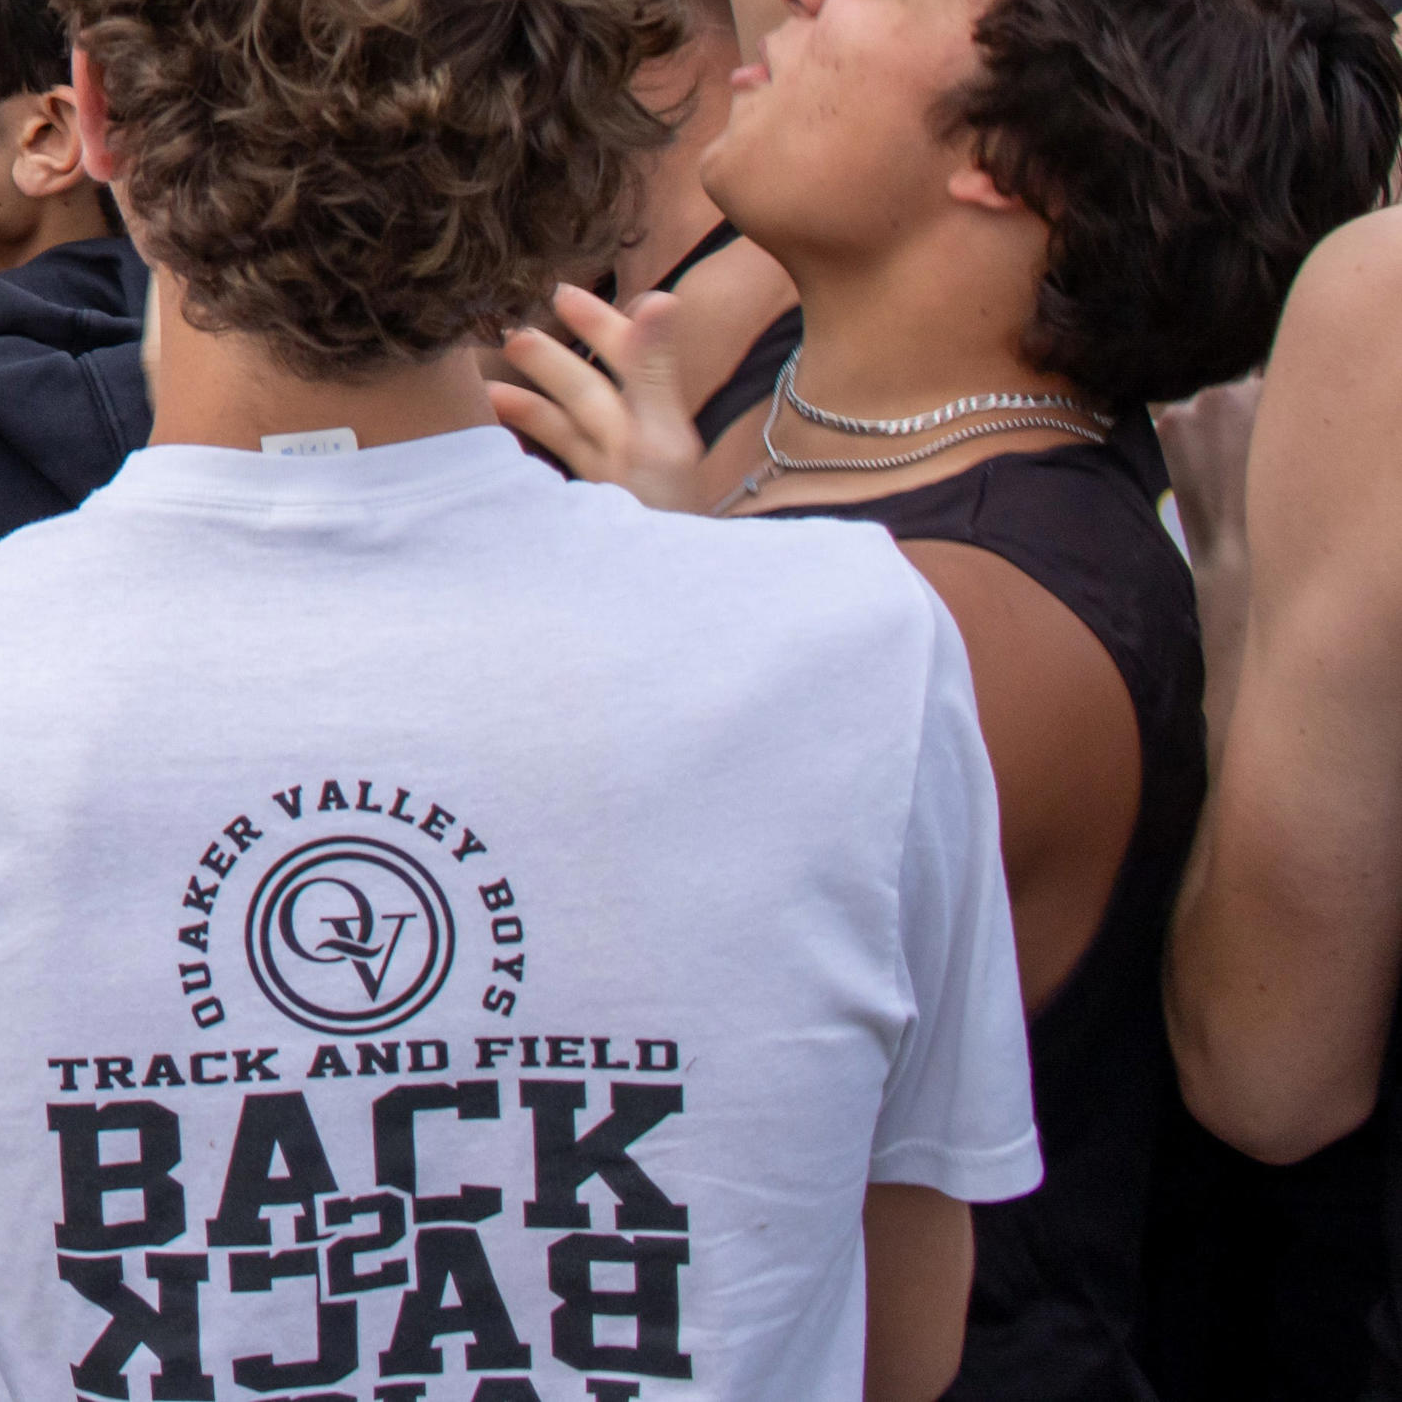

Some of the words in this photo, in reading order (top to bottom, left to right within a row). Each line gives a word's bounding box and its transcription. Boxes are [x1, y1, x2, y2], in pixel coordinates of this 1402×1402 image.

[178, 814, 263, 1029] QUAKER
[272, 779, 487, 863] VALLEY
[478, 877, 525, 1017] BOYS
[278, 877, 418, 1002] QV
[47, 1048, 280, 1091] TRACK
[305, 1039, 450, 1079] AND
[473, 1035, 680, 1073] FIELD
[46, 1078, 689, 1252] BACK
[322, 1191, 410, 1297] 2
